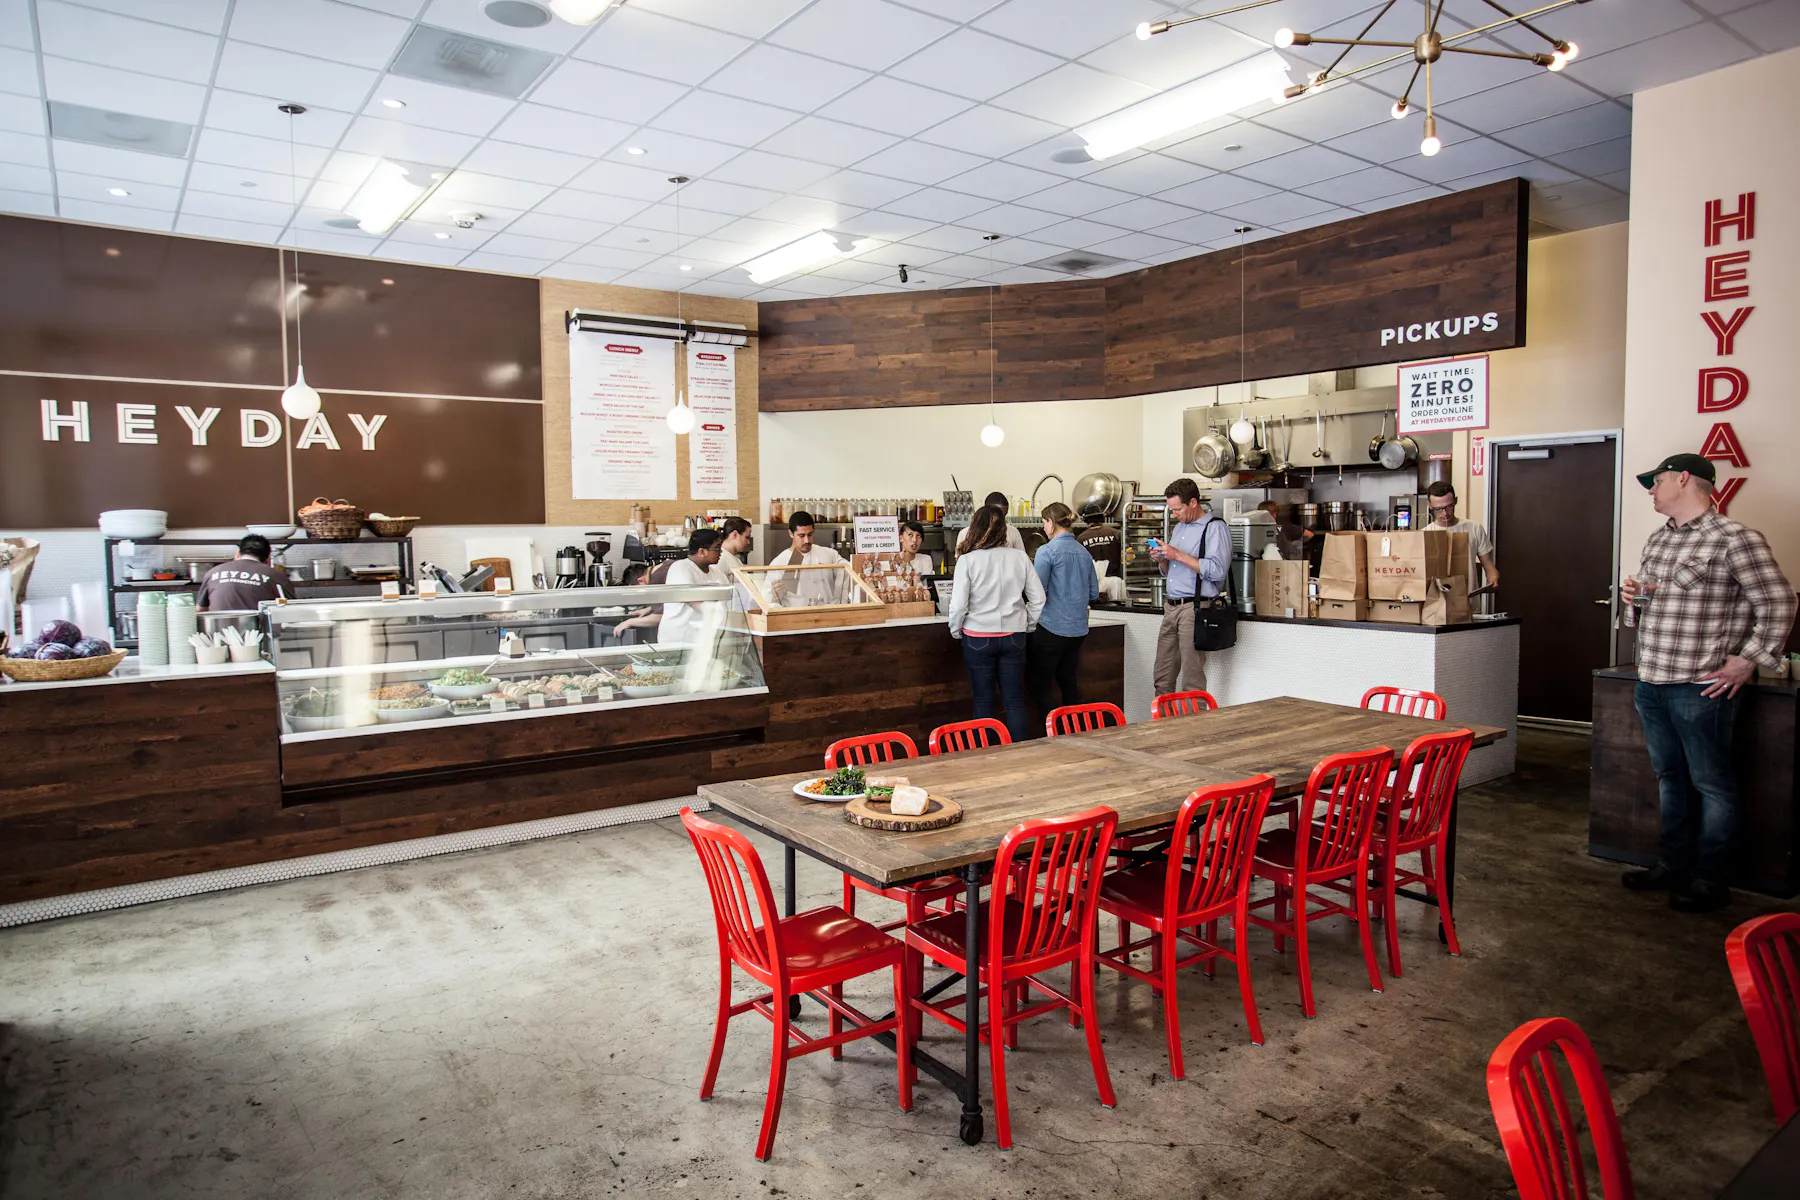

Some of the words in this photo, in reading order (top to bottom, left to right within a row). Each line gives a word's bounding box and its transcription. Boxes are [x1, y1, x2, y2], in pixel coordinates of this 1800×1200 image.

[1380, 312, 1499, 346] PICKUPS
[1412, 371, 1438, 381] WAIT
[1443, 367, 1474, 377] TIME:
[1411, 378, 1473, 398] ZERO
[1411, 394, 1473, 408] MINUTES!
[1411, 409, 1439, 418] ORDER
[1441, 406, 1473, 414] ONLINE
[40, 400, 387, 450] HEYDAY
[1421, 415, 1474, 424] HEYDAYSF.COM
[1083, 535, 1114, 546] HEYDAY
[212, 570, 270, 583] HEYDAY
